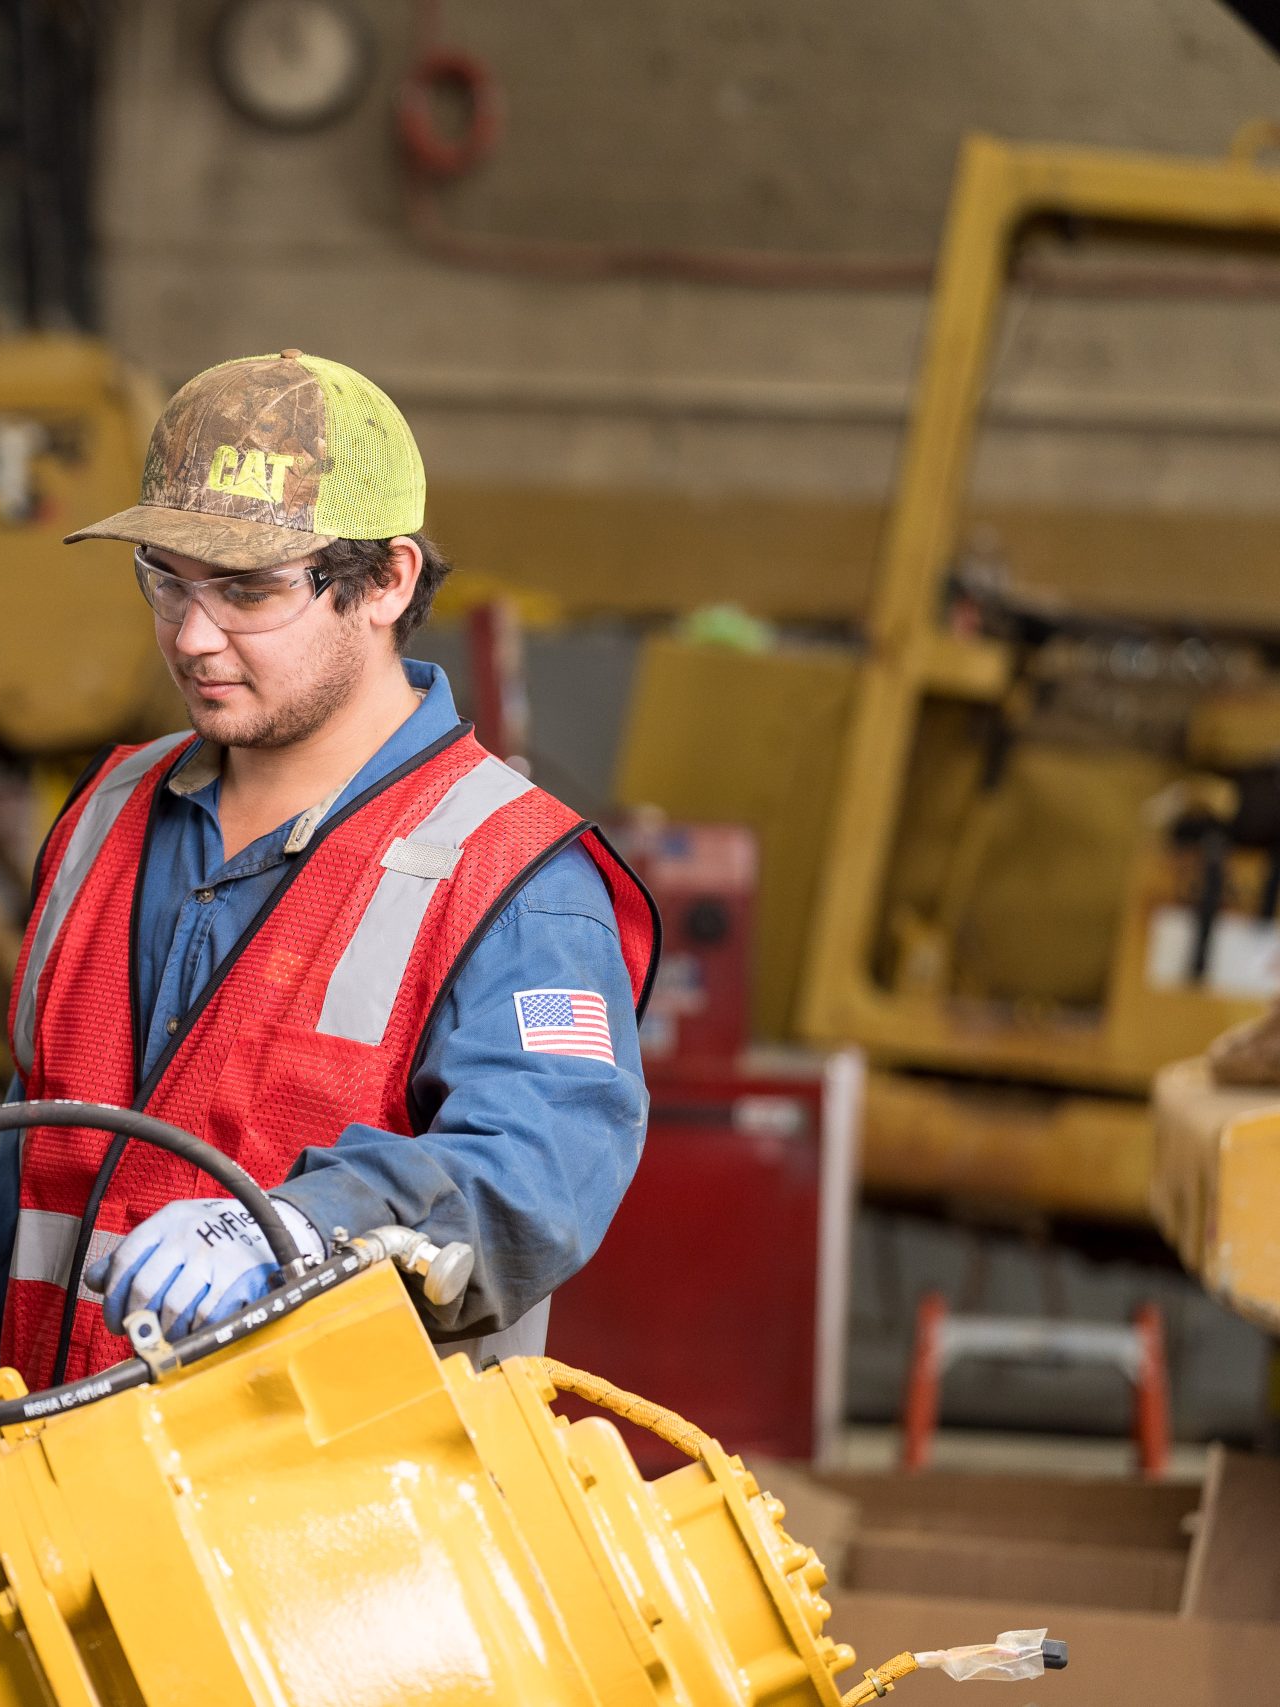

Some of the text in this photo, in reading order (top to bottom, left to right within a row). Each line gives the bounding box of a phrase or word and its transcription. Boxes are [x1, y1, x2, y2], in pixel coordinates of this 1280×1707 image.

[208, 444, 294, 505] CAT
[196, 1210, 256, 1248] HyFle
[23, 1398, 60, 1418] MSHA
